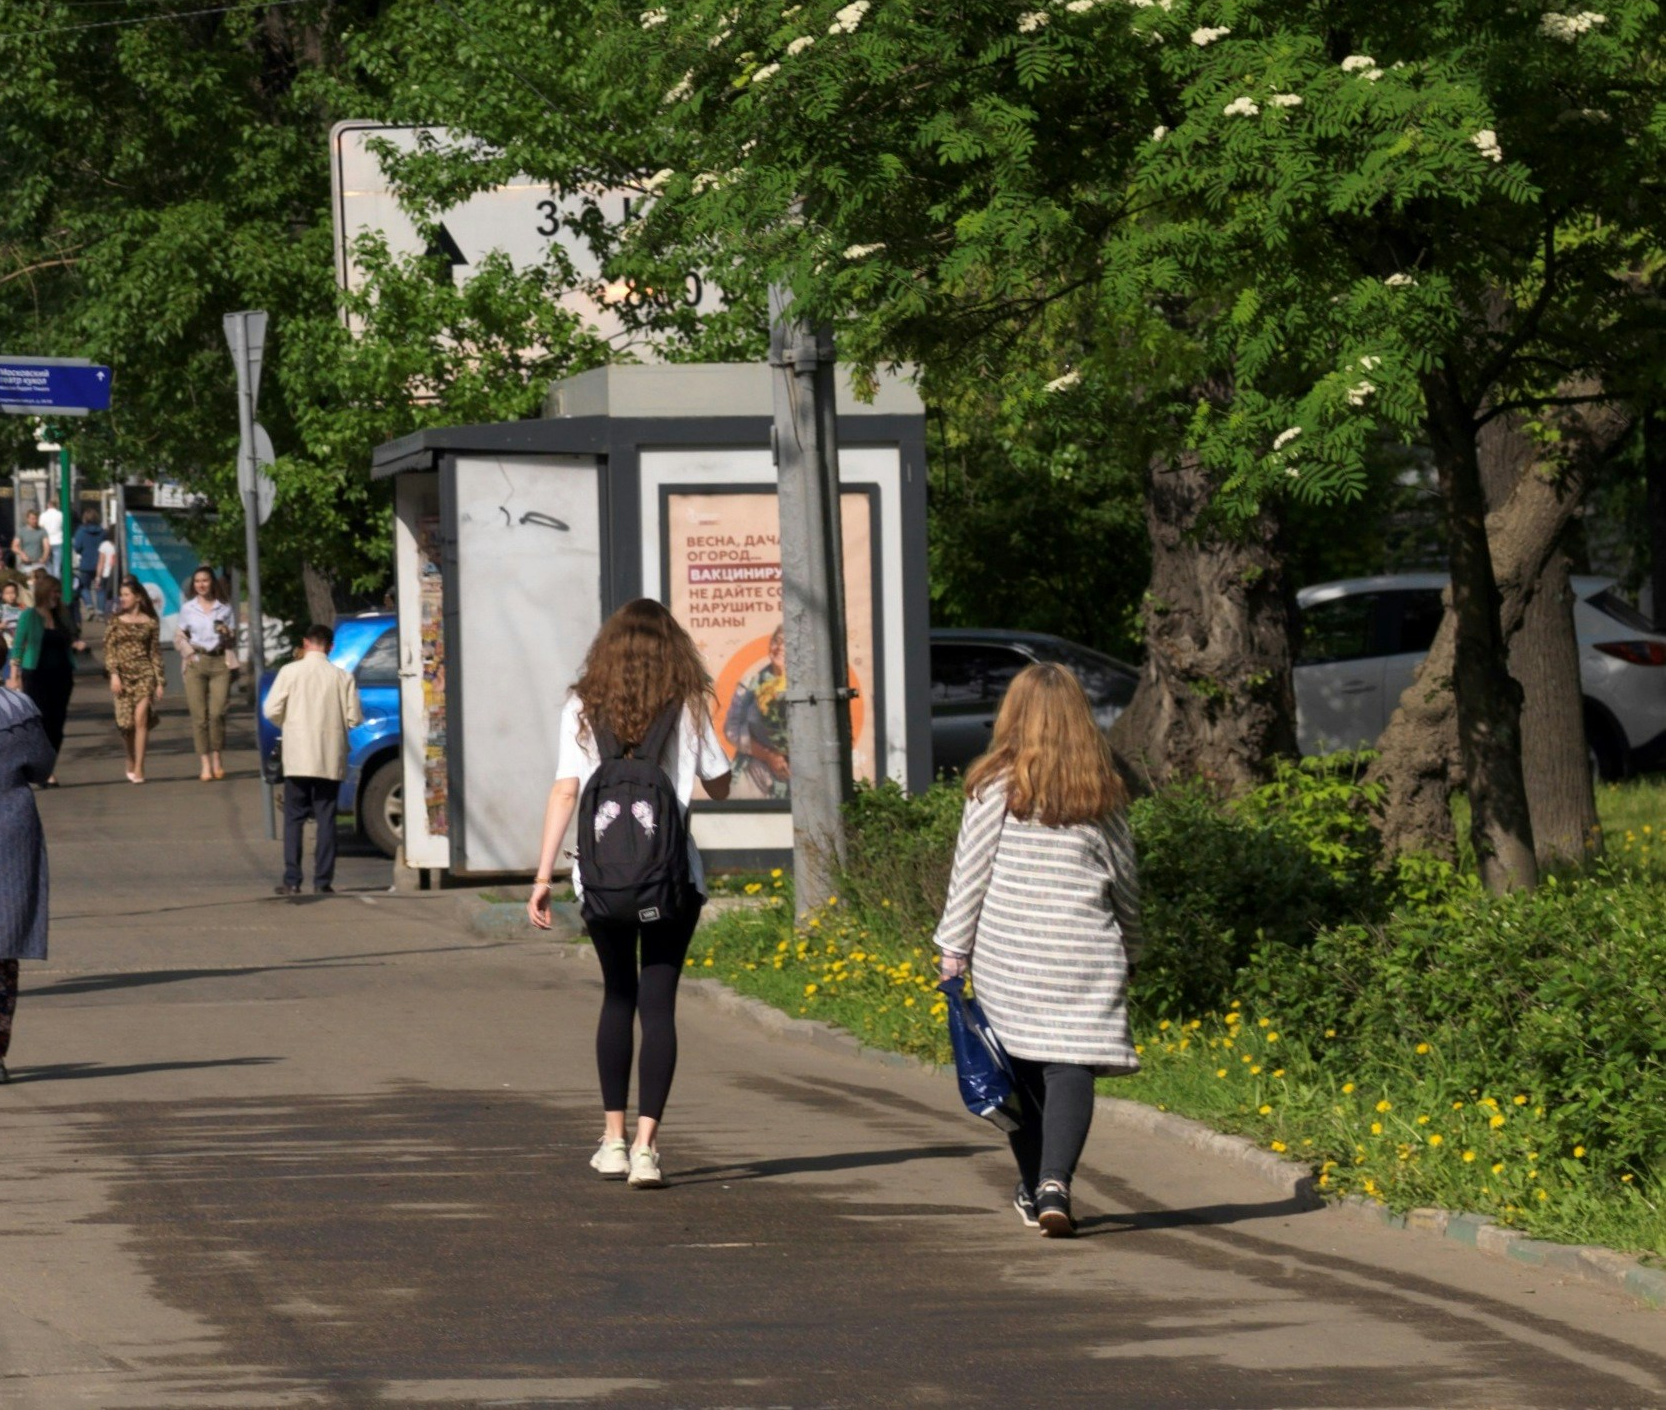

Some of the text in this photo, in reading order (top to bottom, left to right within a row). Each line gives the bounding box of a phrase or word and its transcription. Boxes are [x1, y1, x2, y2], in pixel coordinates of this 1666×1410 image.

[687, 535, 740, 548] ВЕСНА,
[690, 566, 783, 582] ВАКЦИНИРУ
[689, 588, 707, 600] НЕ
[712, 584, 762, 600] ДАЙТЕ
[689, 601, 774, 614] НАРУШИТЬ
[690, 616, 745, 628] ПЛАНЫ
